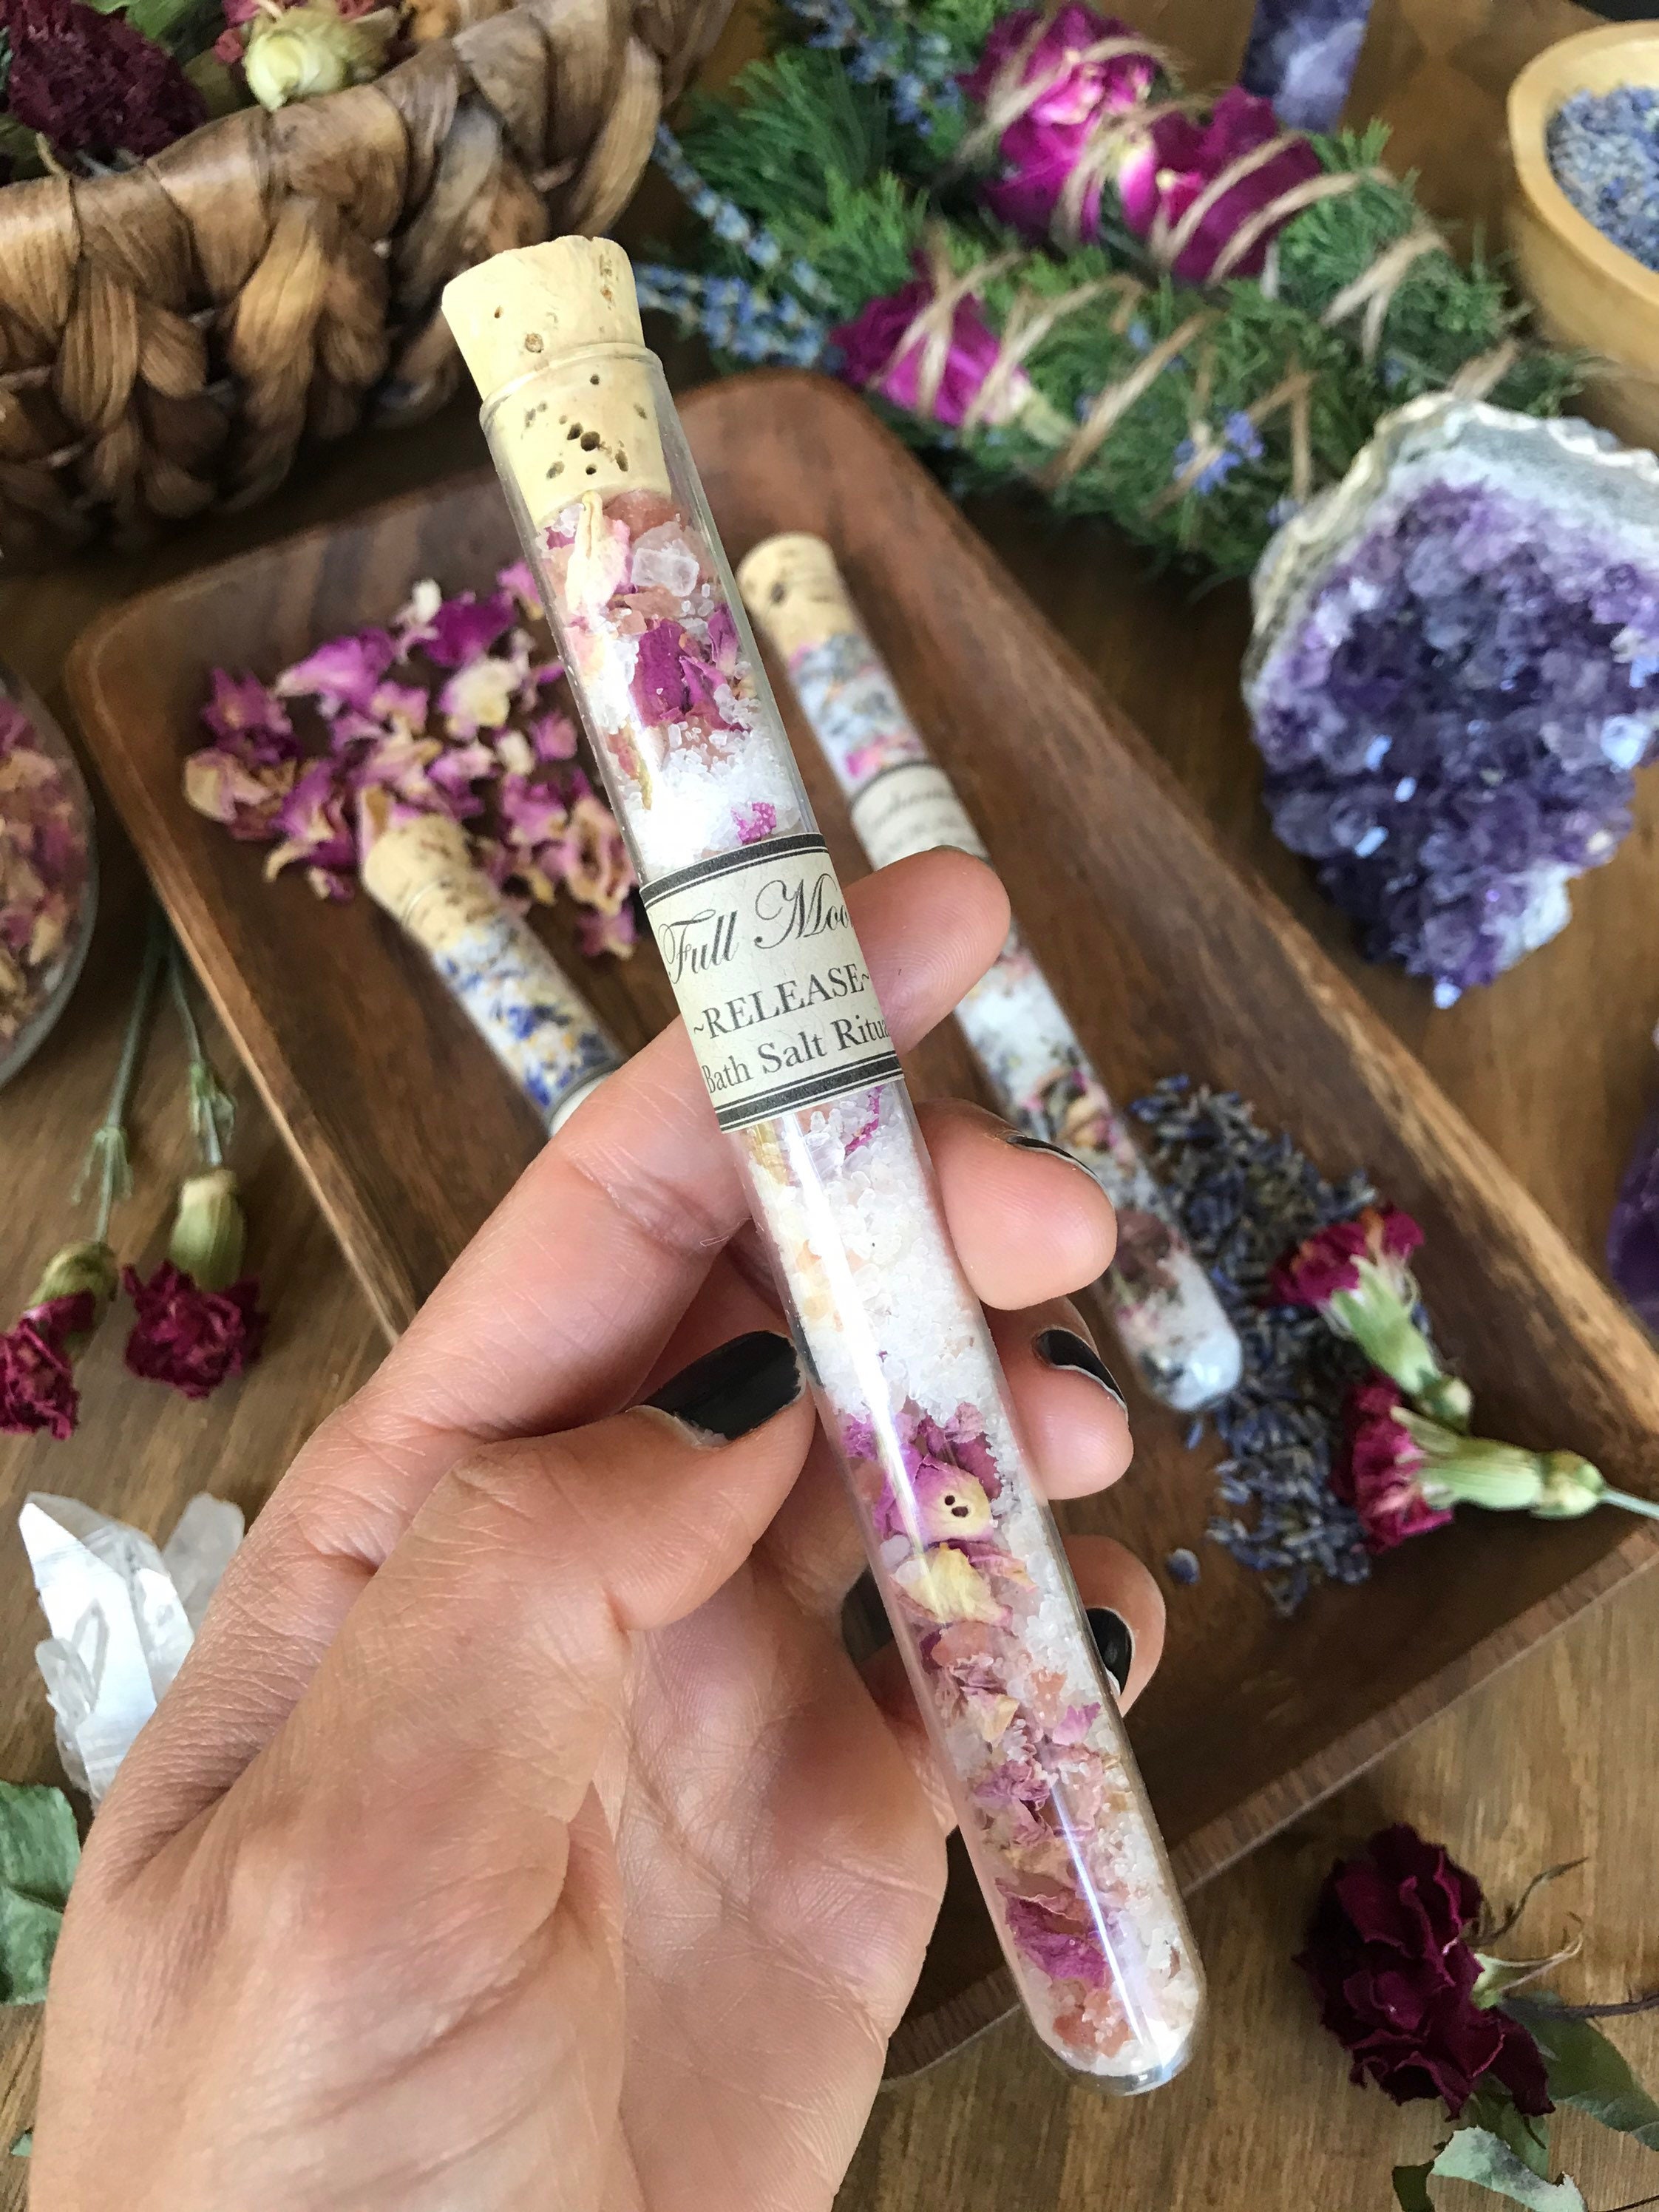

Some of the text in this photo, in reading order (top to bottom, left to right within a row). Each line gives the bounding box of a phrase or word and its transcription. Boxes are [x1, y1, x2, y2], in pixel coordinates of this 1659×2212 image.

[658, 873, 852, 984] Full Moo
[701, 1014, 891, 1094] Bath Salt Ritua
